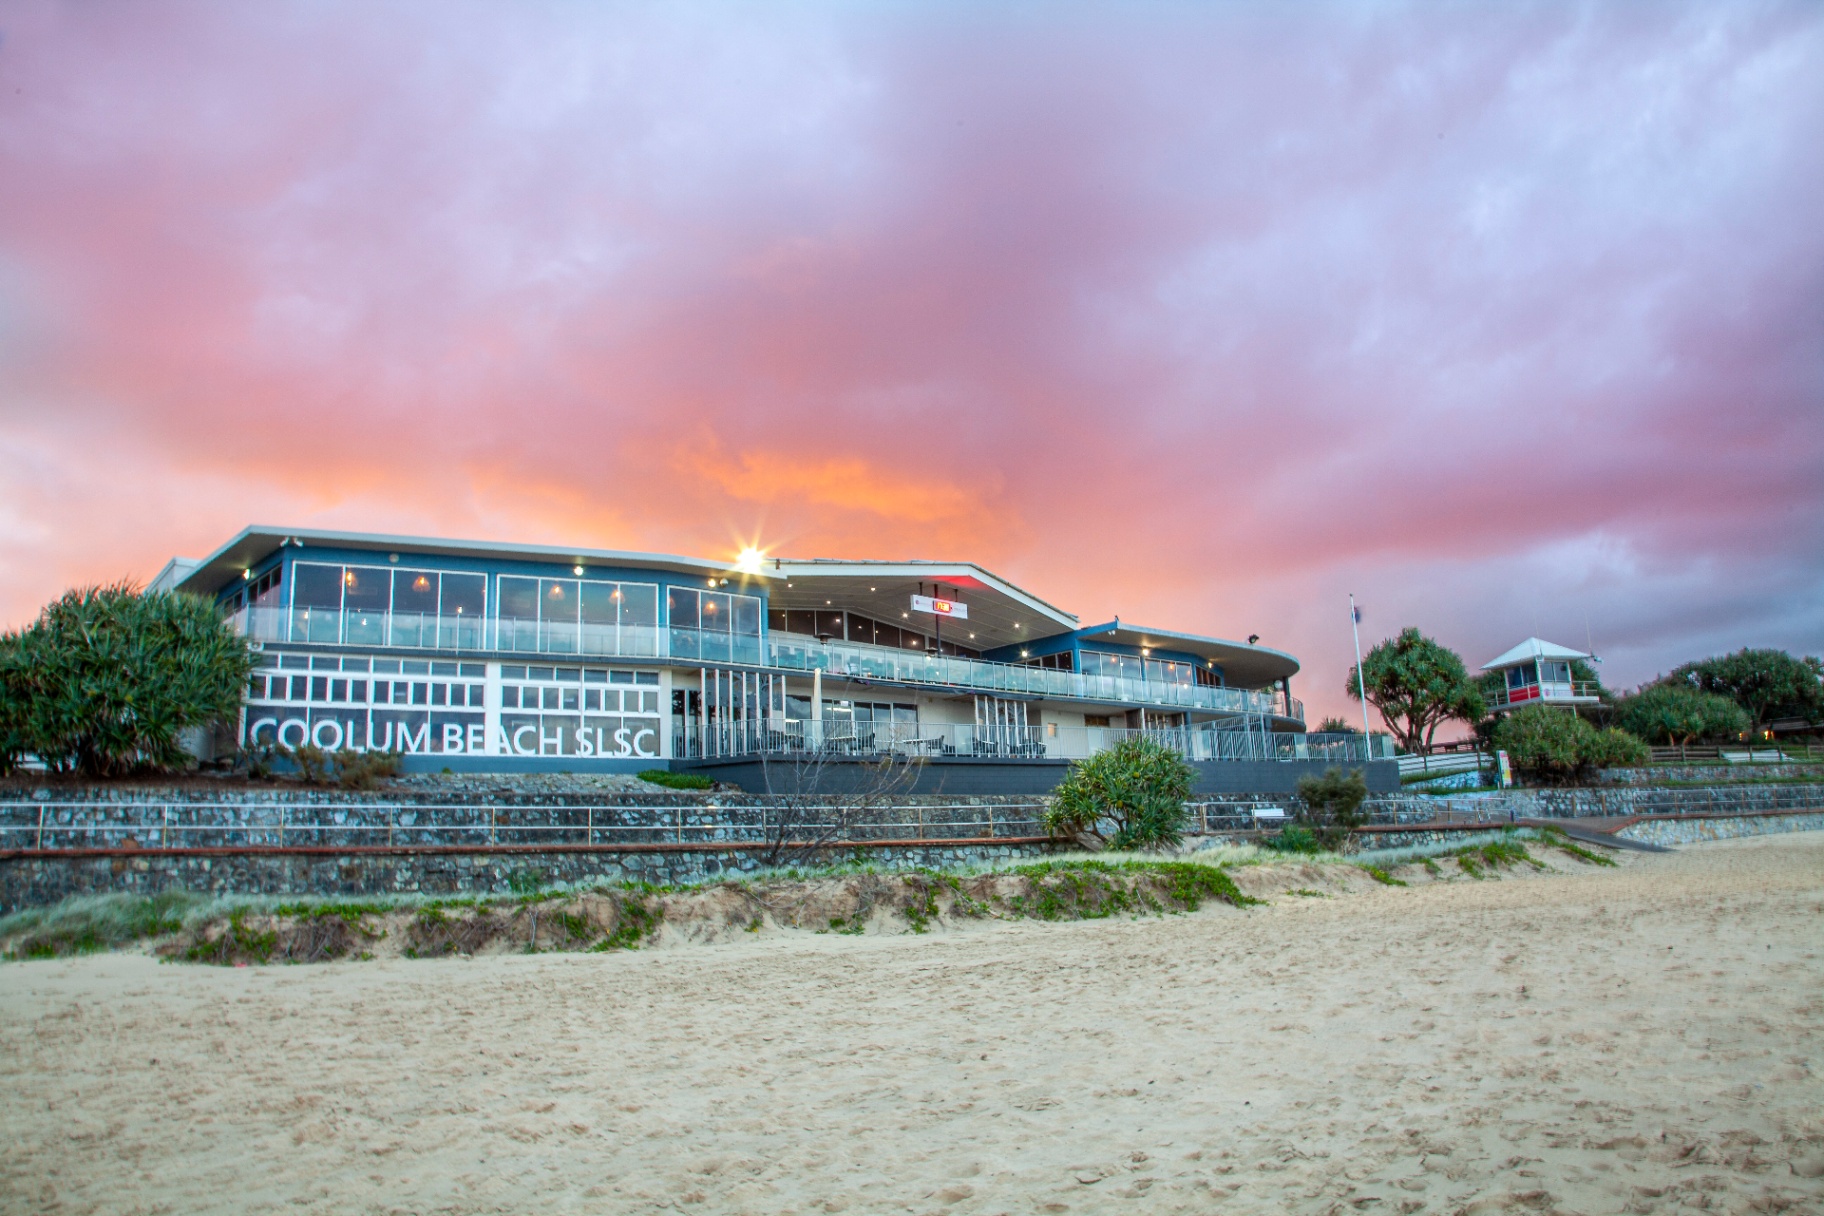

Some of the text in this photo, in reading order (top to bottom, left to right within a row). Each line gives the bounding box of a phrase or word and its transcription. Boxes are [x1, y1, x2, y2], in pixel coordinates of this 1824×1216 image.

[250, 717, 655, 757] COOLUM BEACH SLSC
